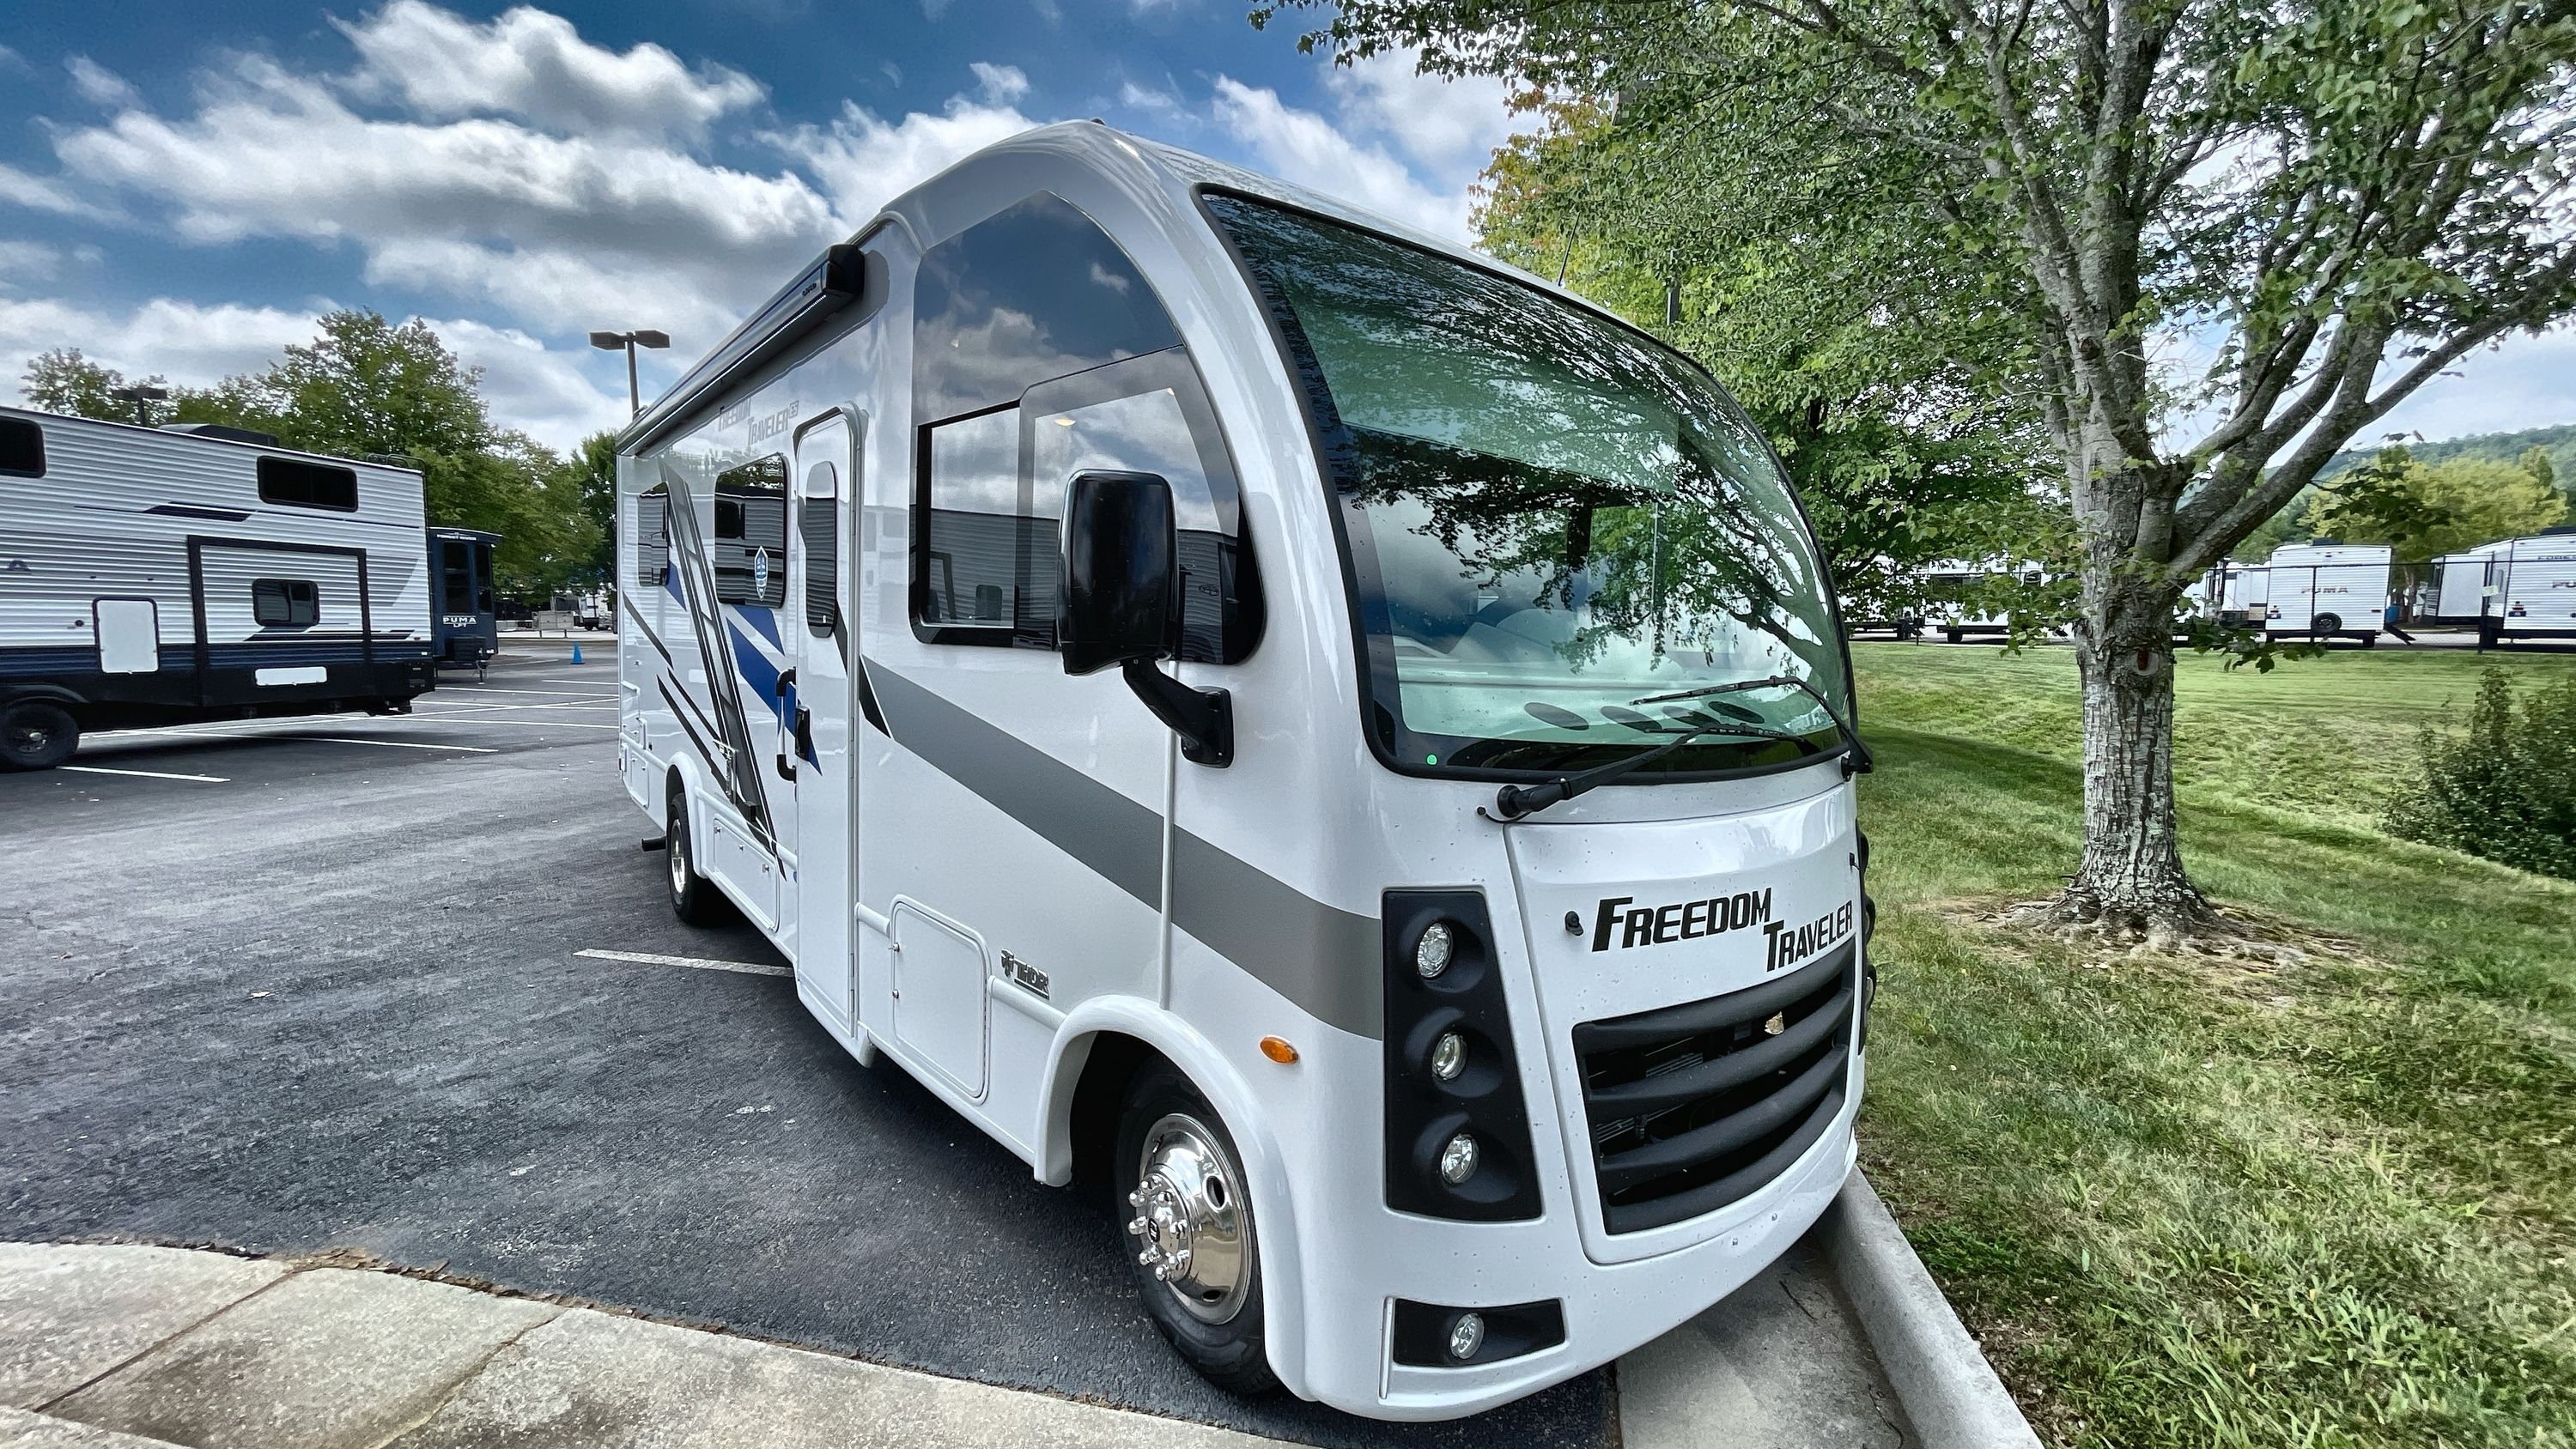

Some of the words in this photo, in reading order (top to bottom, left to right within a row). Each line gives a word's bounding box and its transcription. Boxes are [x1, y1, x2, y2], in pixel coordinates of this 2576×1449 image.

[747, 408, 789, 447] TRAVELER
[1592, 888, 1772, 952] FREEDOM
[1763, 900, 1852, 972] TRAVELER
[1013, 957, 1049, 997] THOR
